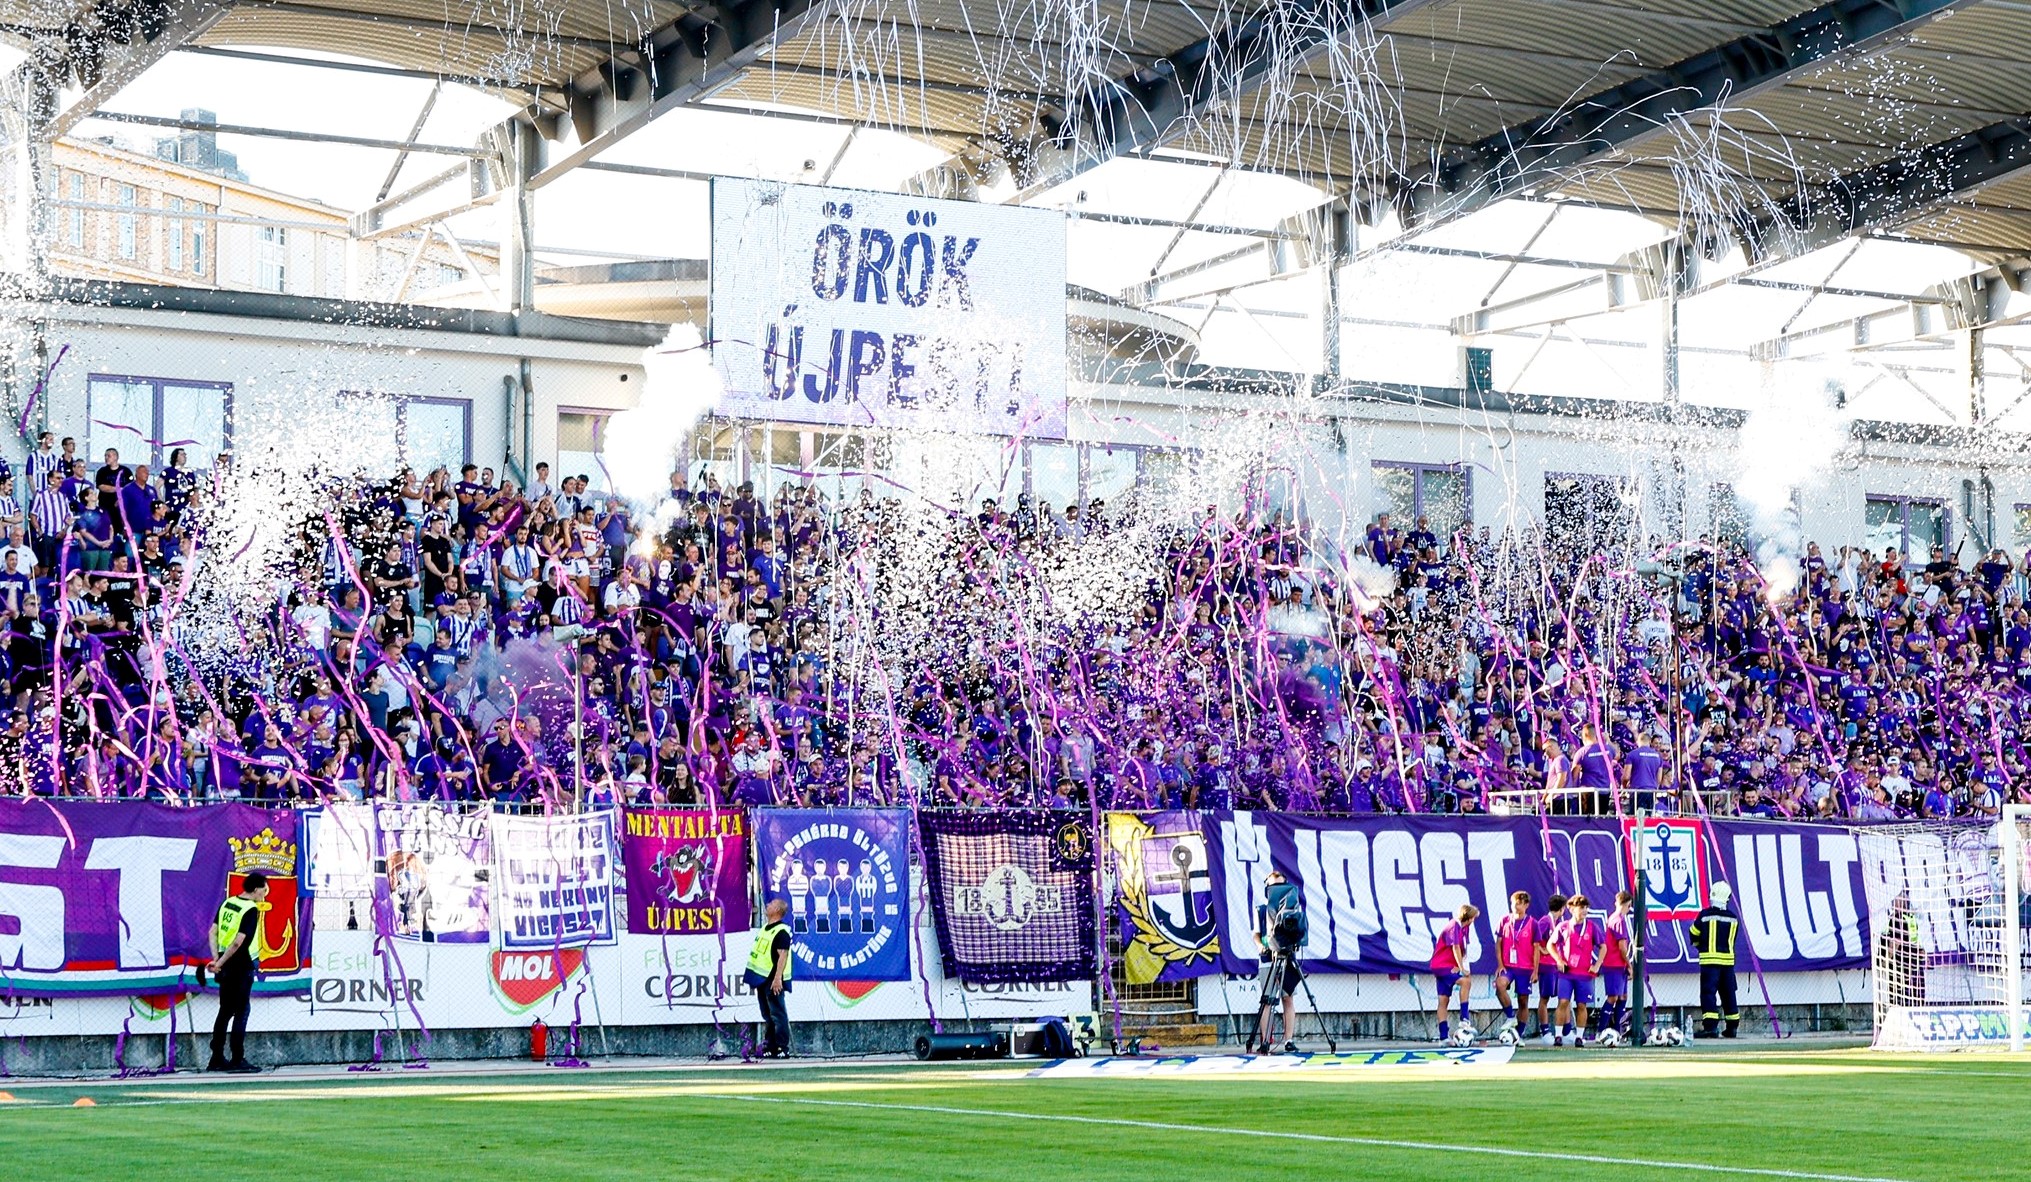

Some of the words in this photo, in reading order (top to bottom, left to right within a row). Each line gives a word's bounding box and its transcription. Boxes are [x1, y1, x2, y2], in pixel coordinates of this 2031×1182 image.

[811, 201, 981, 312] ÖRÖK
[763, 304, 1025, 416] ÚJPEST!
[1671, 857, 1688, 871] 85
[646, 901, 722, 930] ÚJPEST
[501, 956, 553, 980] MOL
[1075, 1016, 1096, 1043] 3
